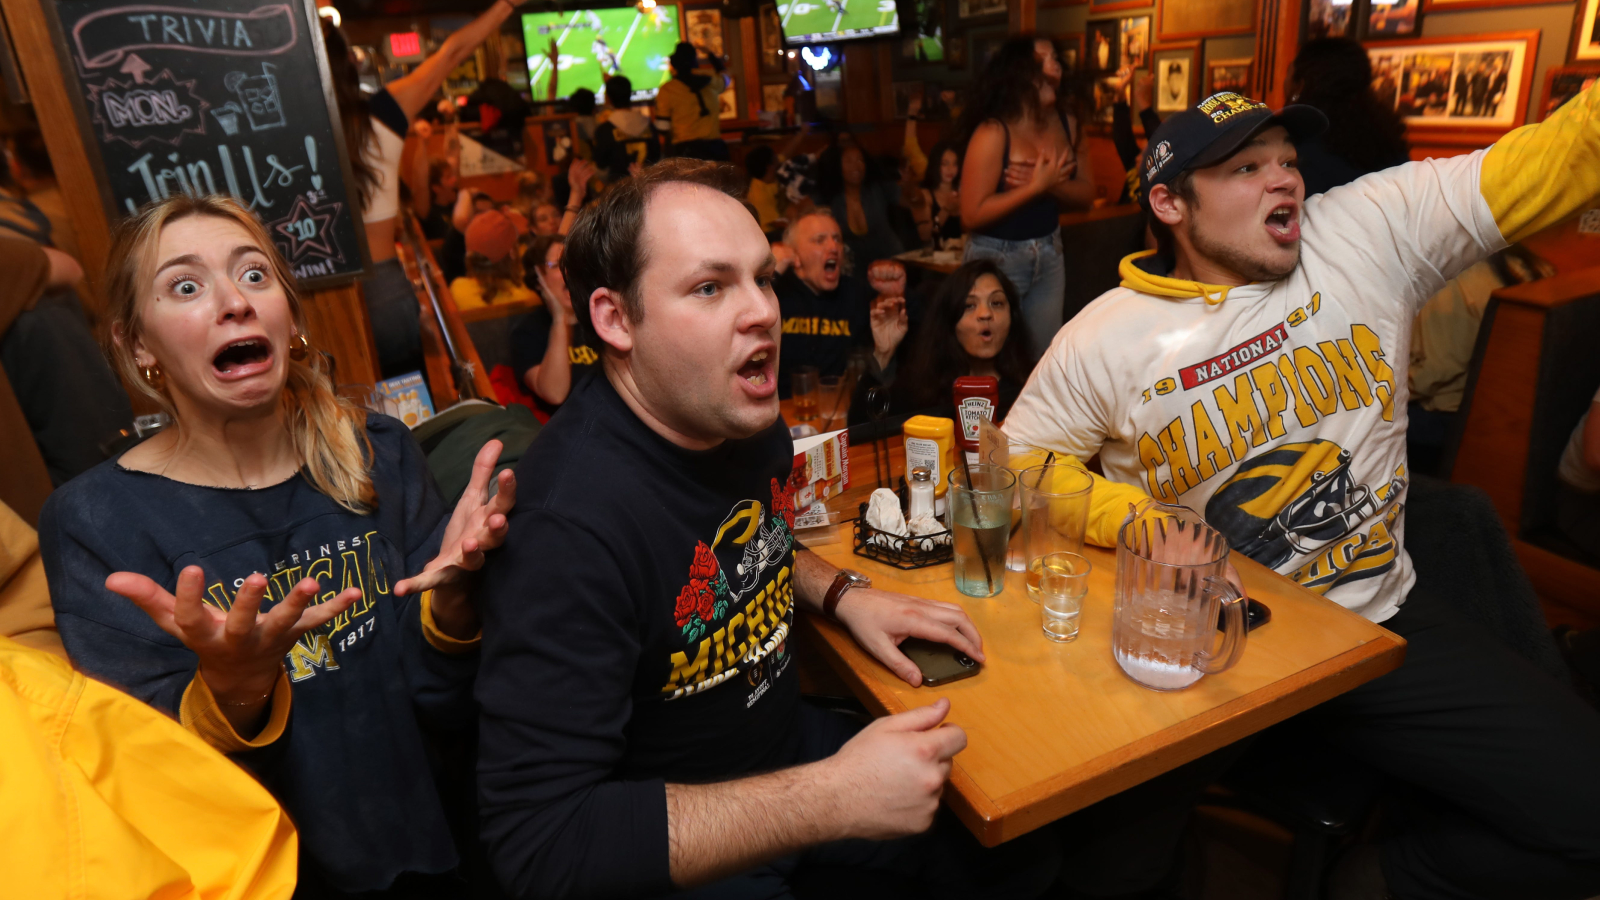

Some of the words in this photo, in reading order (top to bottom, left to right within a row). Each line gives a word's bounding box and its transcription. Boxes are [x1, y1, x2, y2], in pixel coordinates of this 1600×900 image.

[127, 14, 253, 48] TRIVIA
[102, 89, 193, 128] MON.
[1200, 98, 1221, 115] ROSE
[126, 151, 218, 214] Join
[1141, 376, 1178, 405] 19
[1194, 327, 1284, 384] NATIONAL
[1286, 291, 1322, 328] 97
[1137, 323, 1397, 506] CHAMPIONS
[233, 535, 362, 588] OERINES
[339, 616, 377, 653] 1817
[661, 549, 797, 692] MICHIG
[286, 634, 340, 682] M
